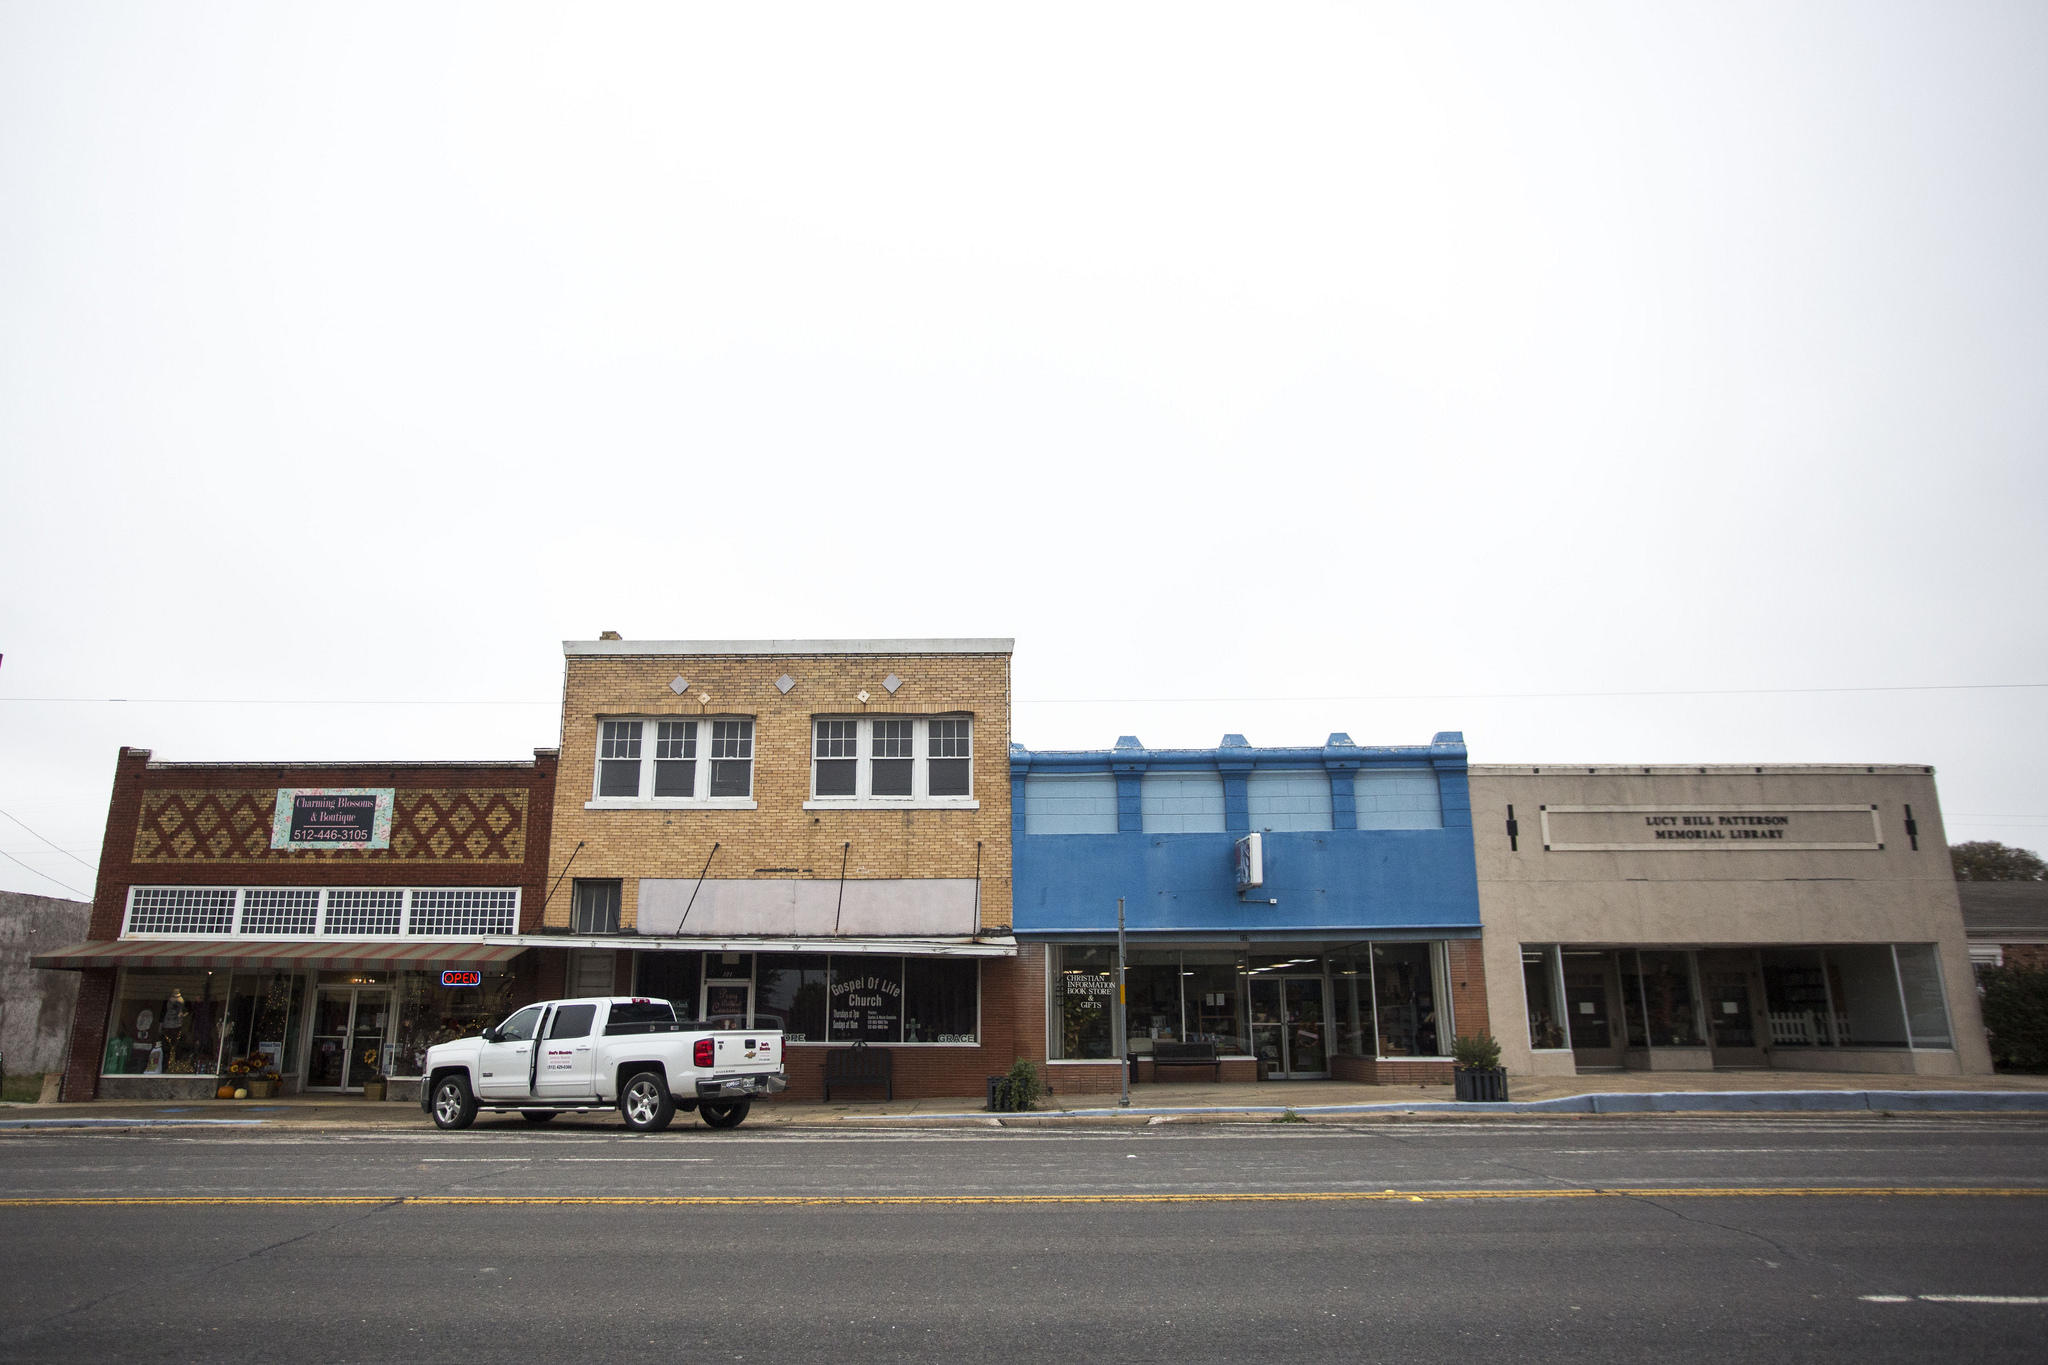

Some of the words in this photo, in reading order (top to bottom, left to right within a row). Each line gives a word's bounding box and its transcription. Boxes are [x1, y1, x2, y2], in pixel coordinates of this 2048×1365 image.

[296, 797, 336, 809] Charming
[338, 797, 374, 808] Blossoms
[310, 811, 317, 822] &
[320, 811, 356, 824] Boutique
[1645, 816, 1678, 826] LUCY
[1683, 816, 1714, 826] HILL
[1718, 815, 1789, 825] PATTERSON
[294, 829, 368, 840] 512-446-3105
[1655, 830, 1725, 839] MEMORIAL
[1730, 829, 1784, 839] LIBRARY
[444, 972, 478, 984] OPEN
[831, 977, 864, 996] Gospel
[868, 976, 880, 989] Of
[881, 979, 901, 997] Life
[848, 993, 882, 1007] Church
[783, 1033, 806, 1042] OPE
[937, 1033, 975, 1043] GRACE
